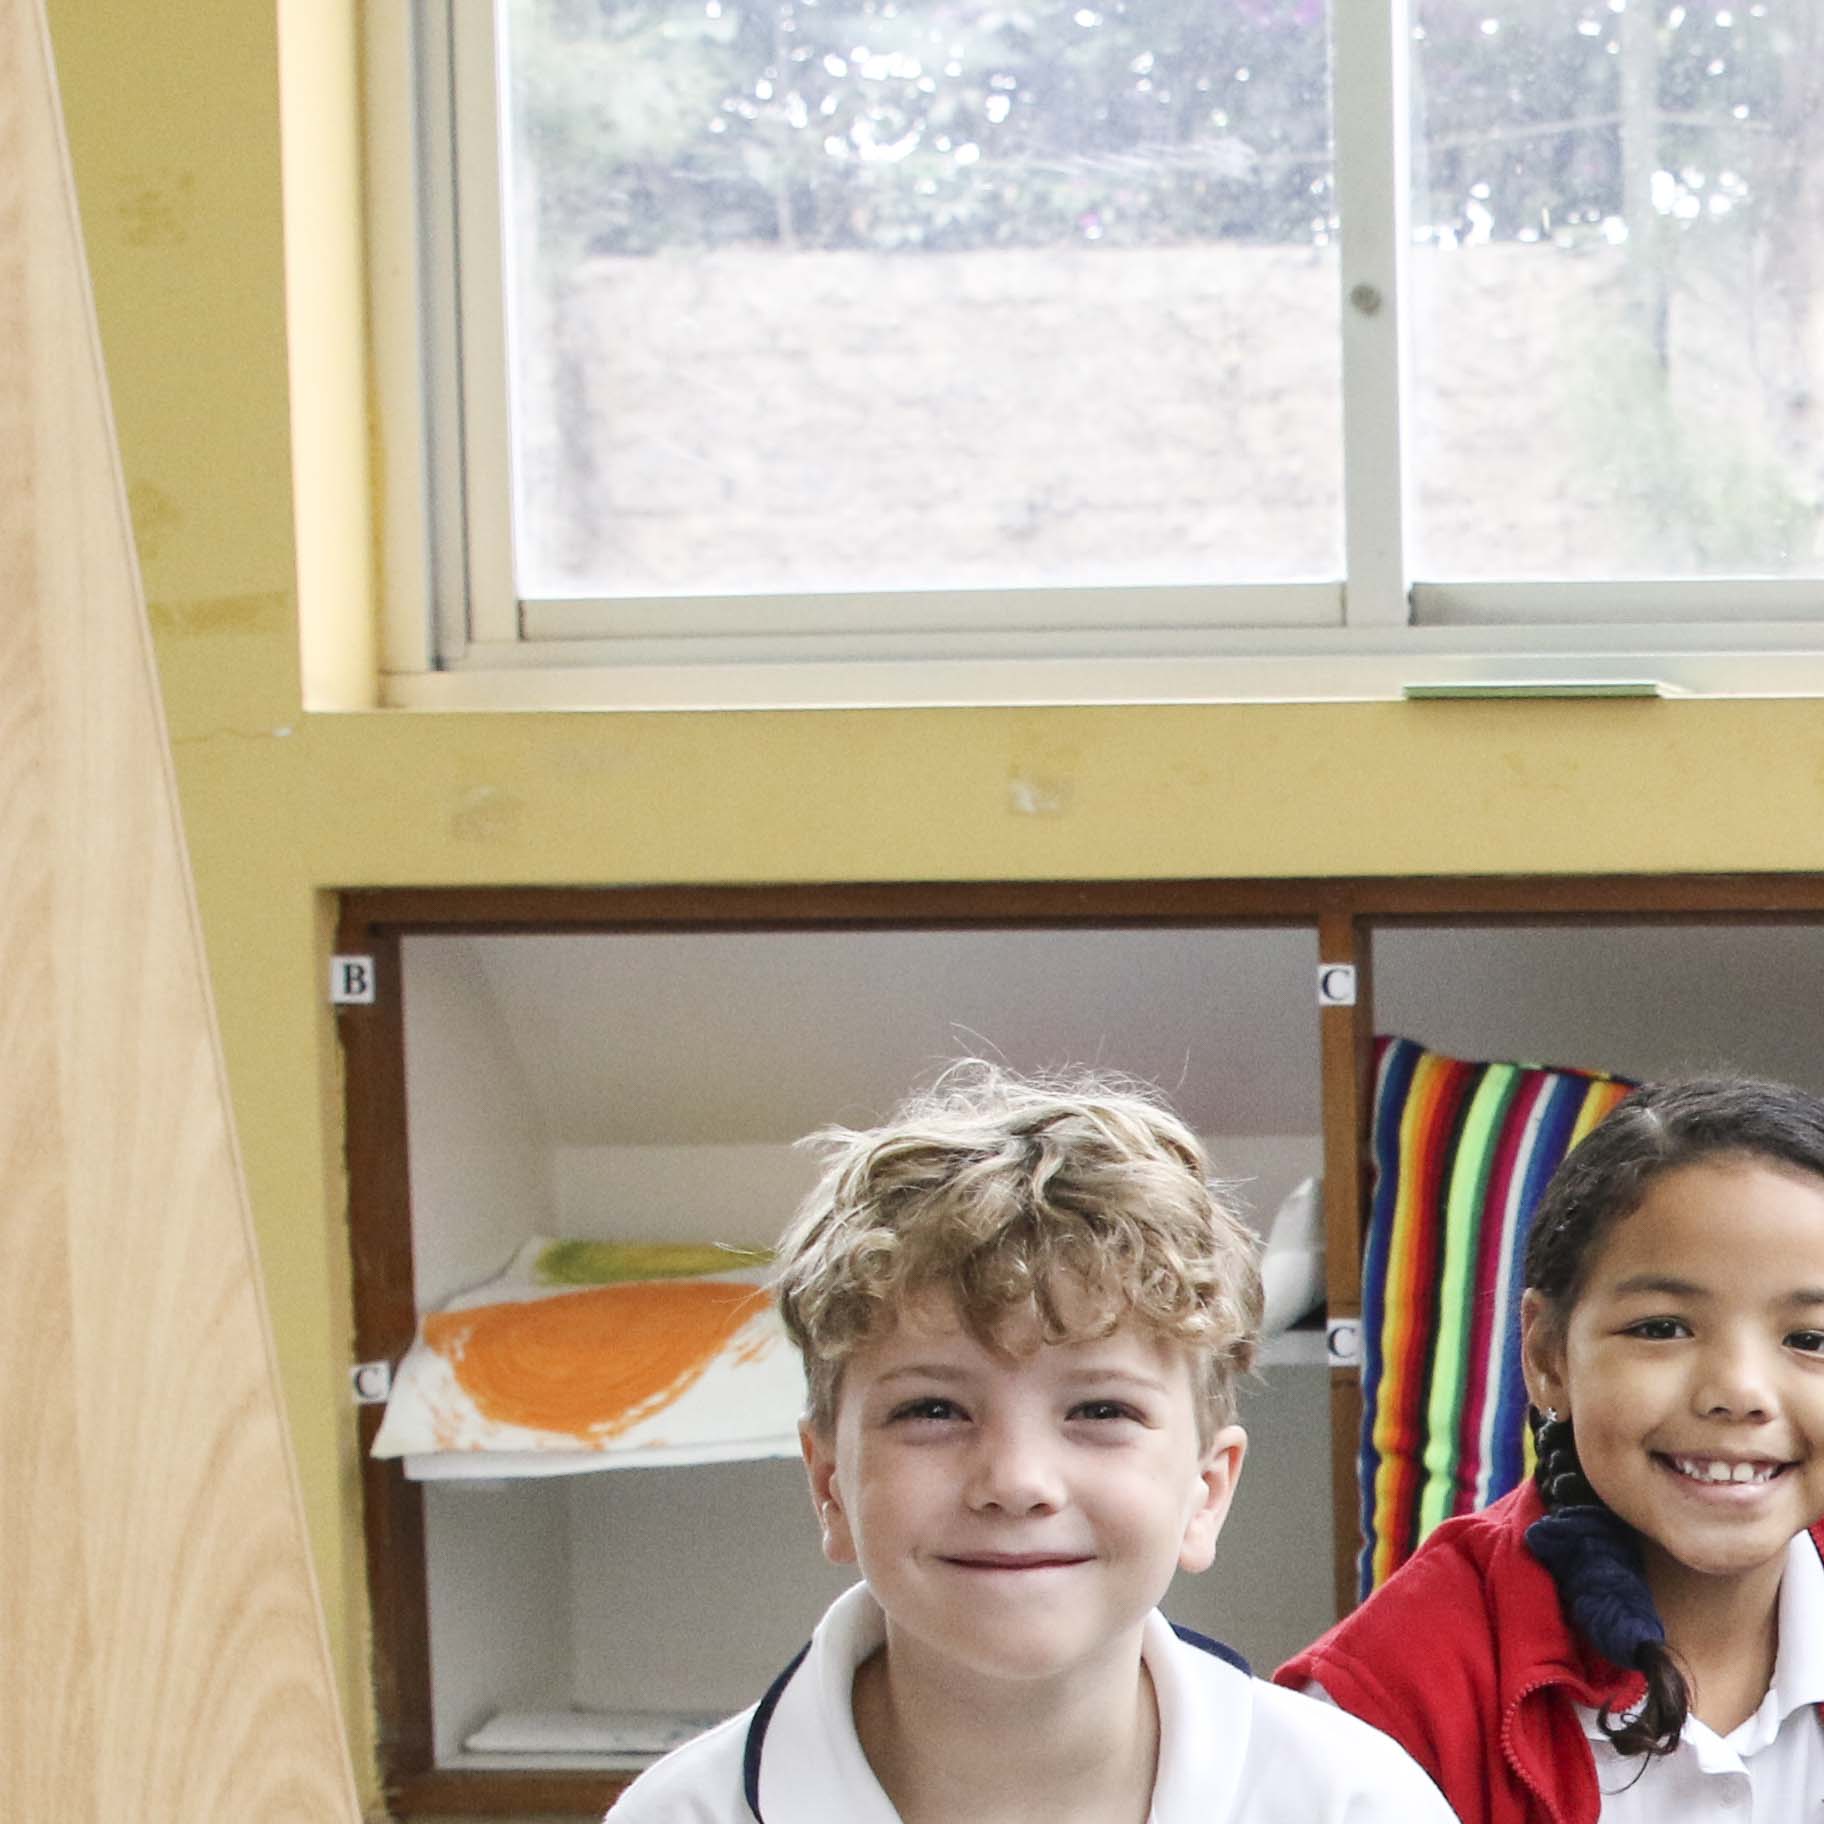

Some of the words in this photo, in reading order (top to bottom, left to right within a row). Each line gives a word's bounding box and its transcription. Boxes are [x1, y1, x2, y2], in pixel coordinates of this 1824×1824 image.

[342, 964, 367, 994] B
[1321, 968, 1350, 1000] C
[1328, 1326, 1355, 1360] C
[354, 1368, 378, 1397] C
